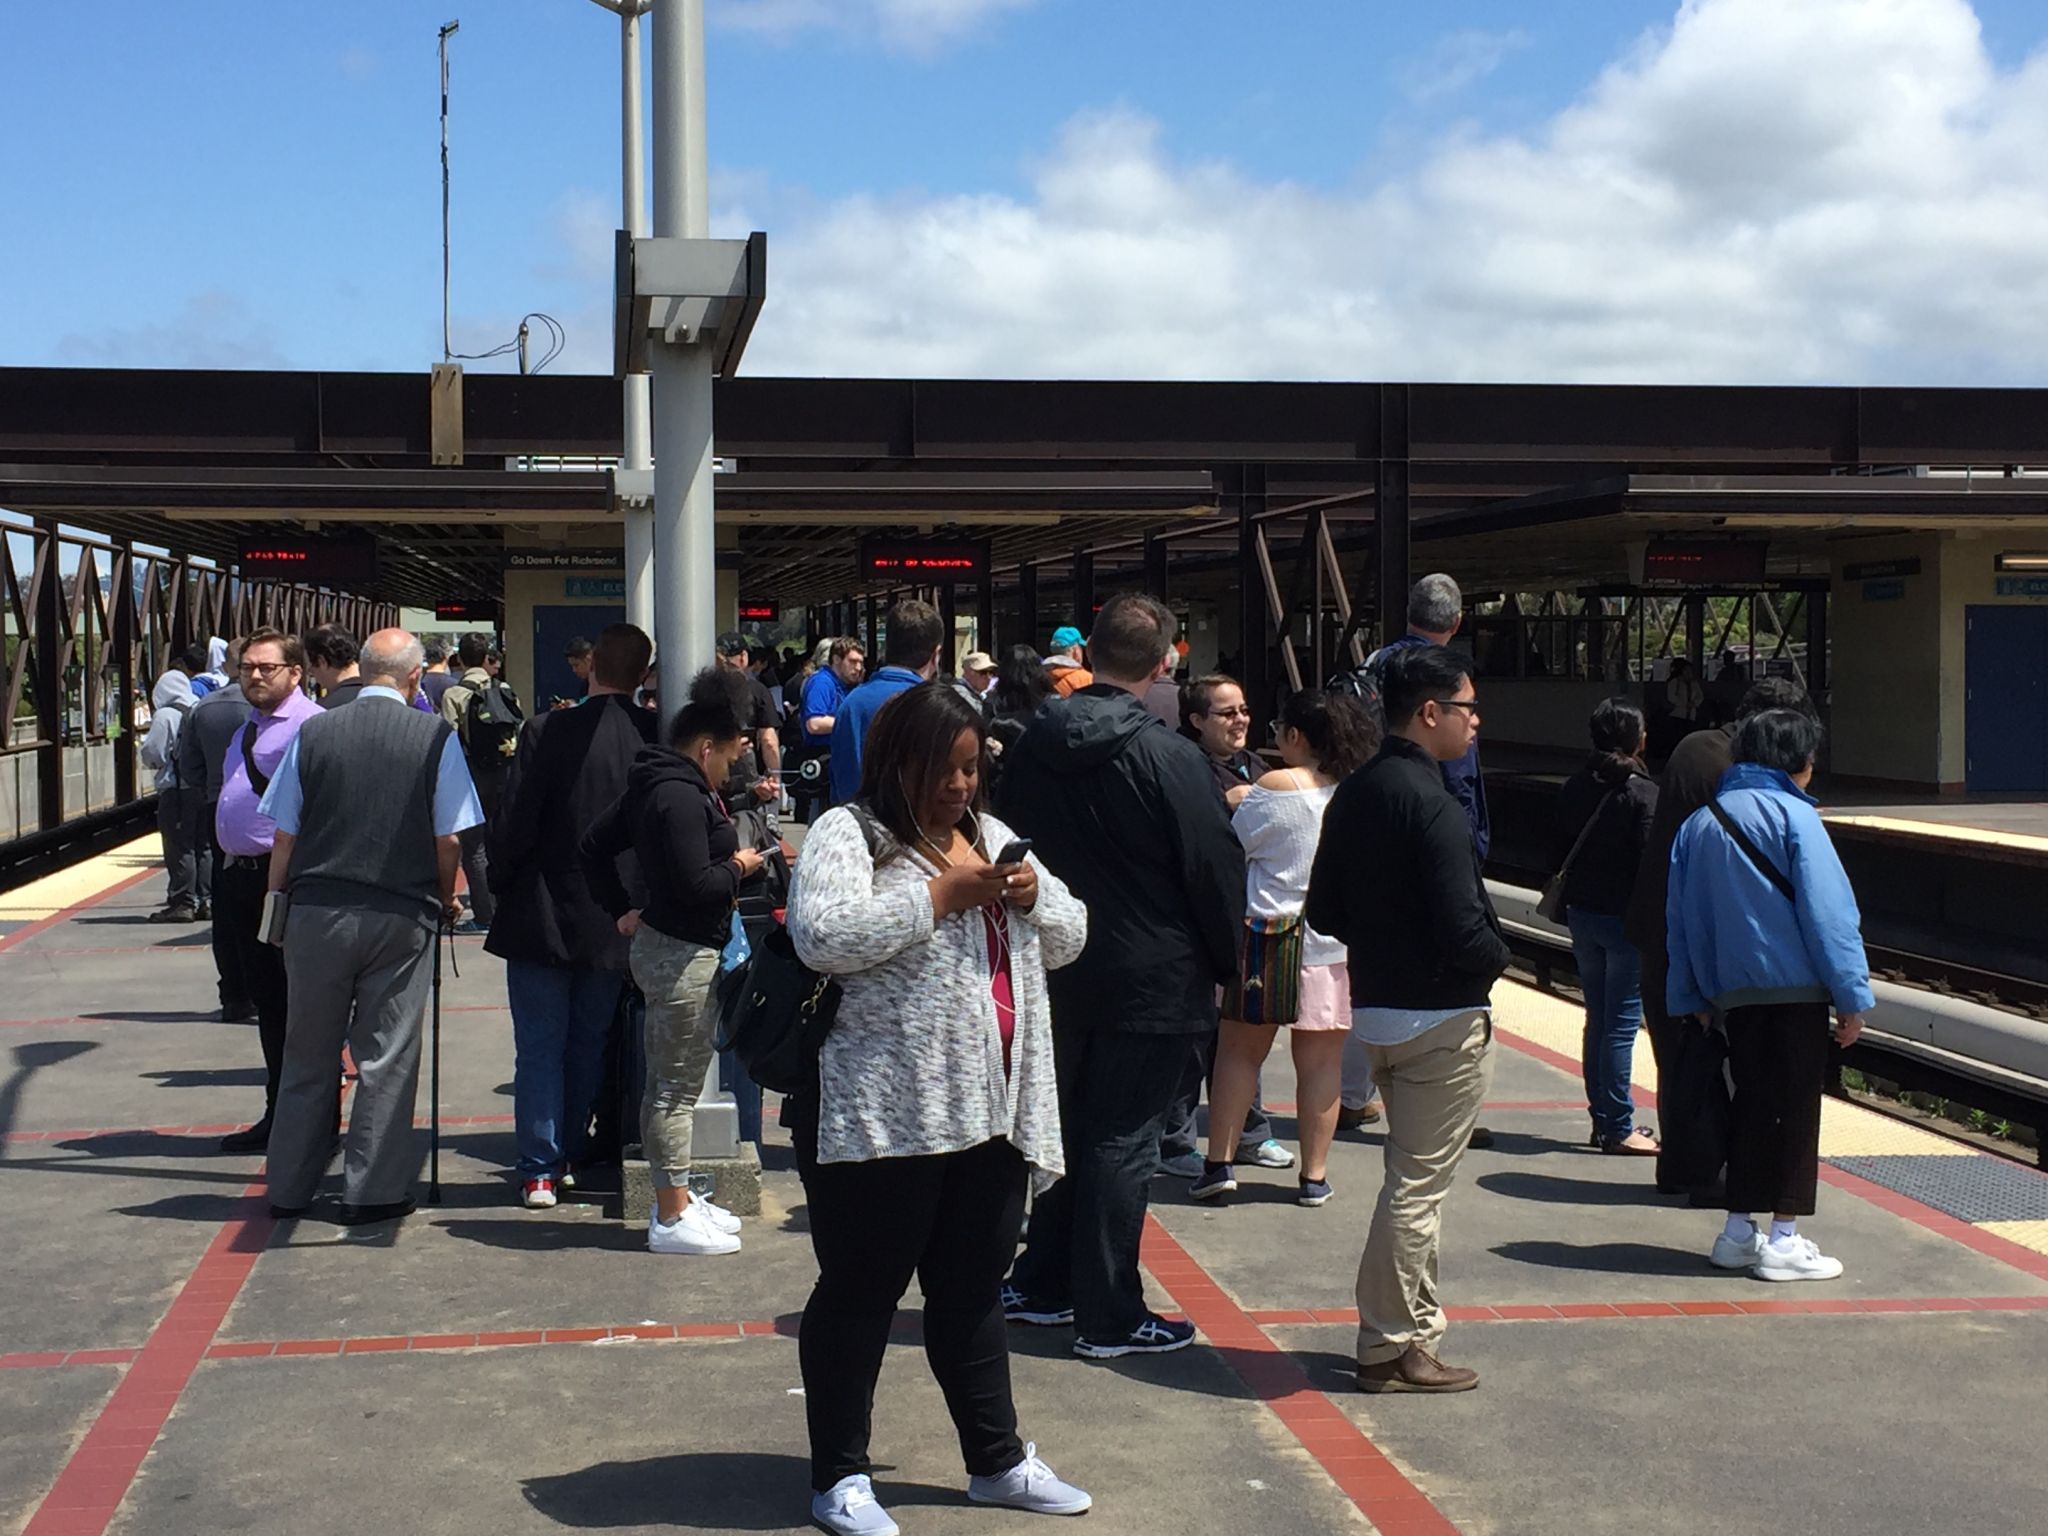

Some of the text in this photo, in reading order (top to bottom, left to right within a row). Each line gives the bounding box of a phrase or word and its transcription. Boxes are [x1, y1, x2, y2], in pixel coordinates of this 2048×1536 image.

[510, 555, 617, 566] Go Down For Richmond
